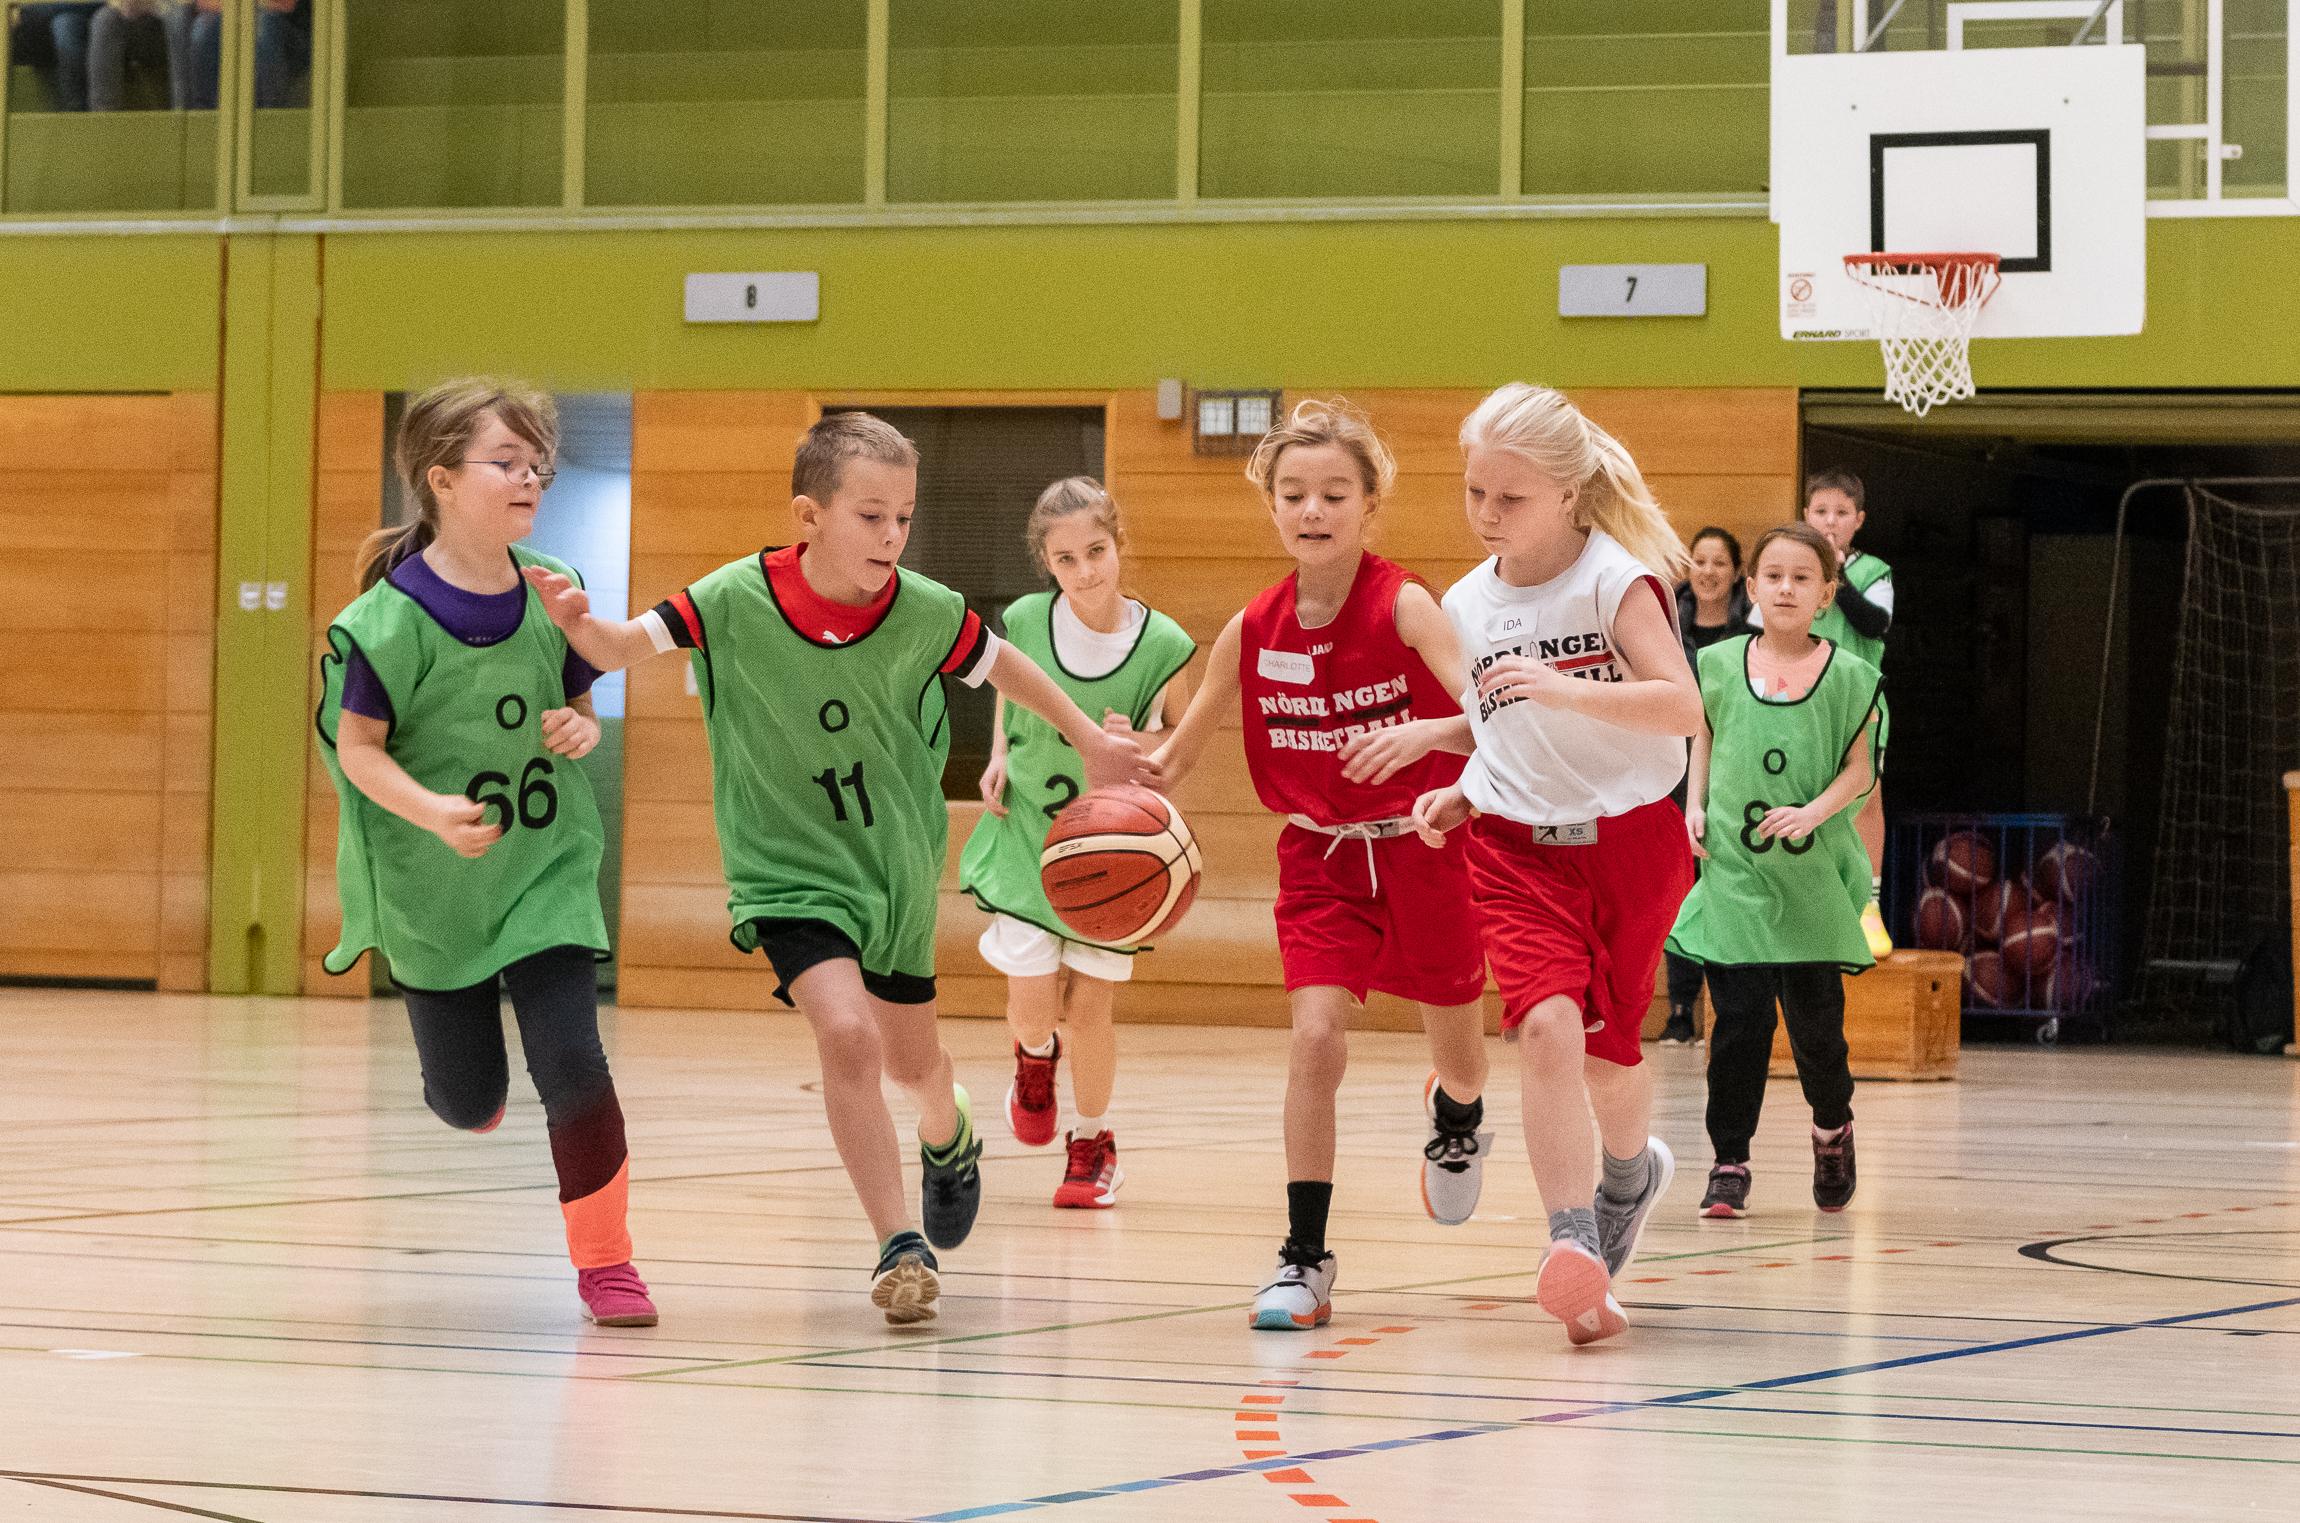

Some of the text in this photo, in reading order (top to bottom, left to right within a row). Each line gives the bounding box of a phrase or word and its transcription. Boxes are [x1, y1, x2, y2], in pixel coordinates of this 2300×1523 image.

[746, 285, 757, 308] 8
[1626, 276, 1637, 302] 7
[1503, 617, 1522, 631] IDA
[465, 757, 558, 836] 66
[812, 761, 874, 828] 11
[1569, 827, 1583, 836] XS
